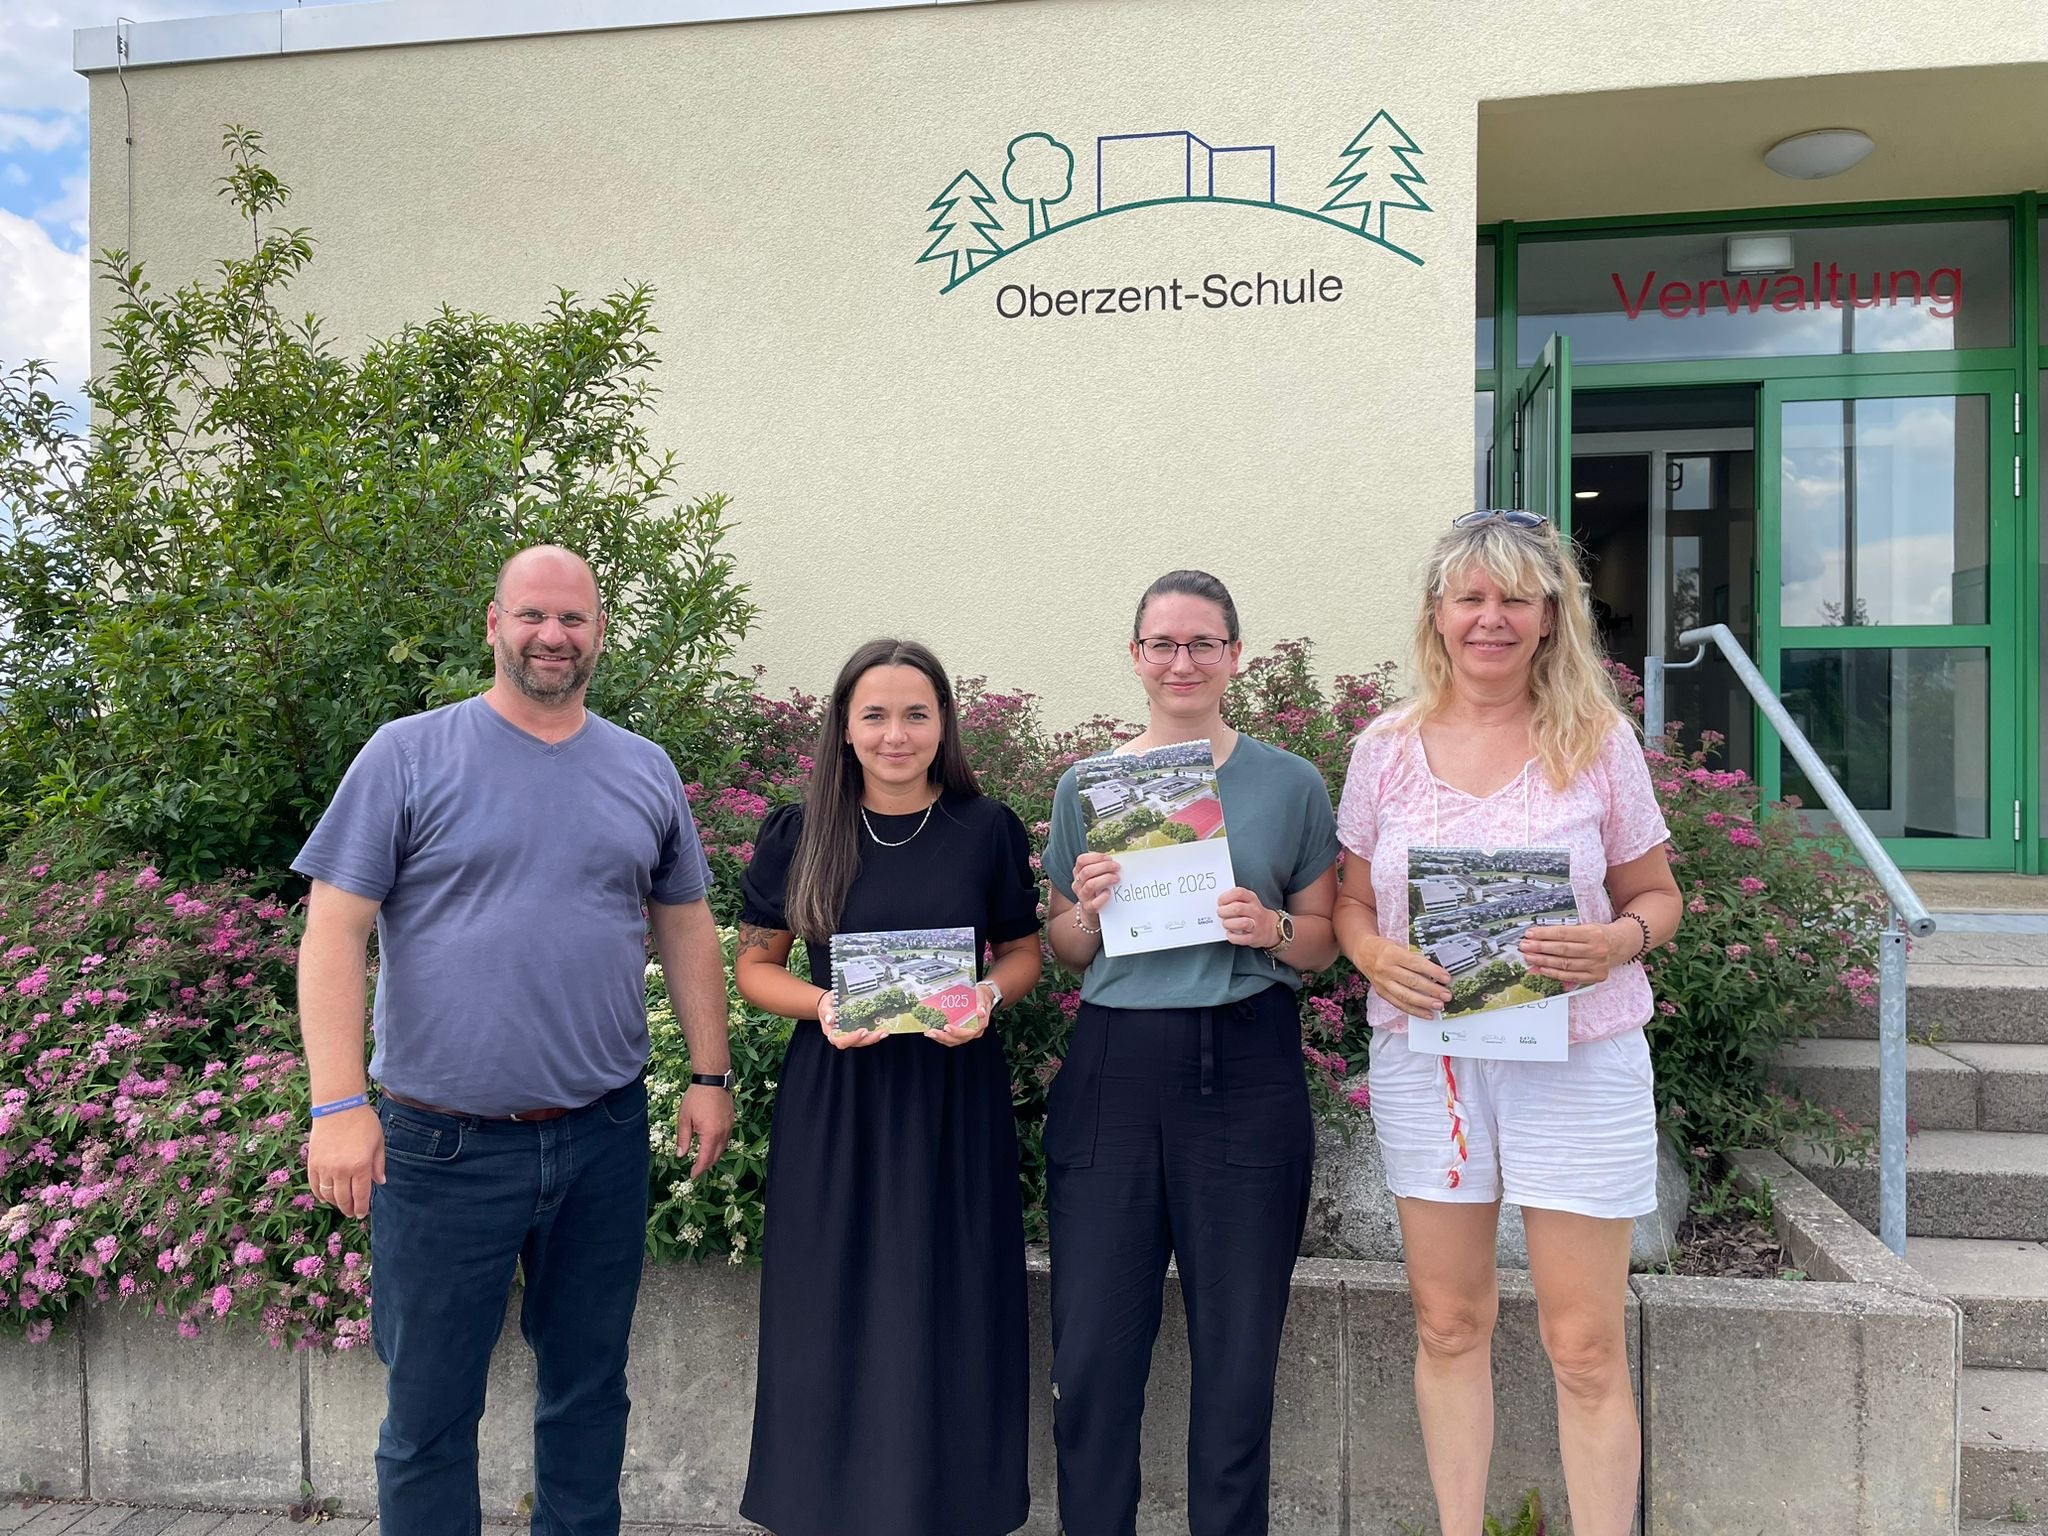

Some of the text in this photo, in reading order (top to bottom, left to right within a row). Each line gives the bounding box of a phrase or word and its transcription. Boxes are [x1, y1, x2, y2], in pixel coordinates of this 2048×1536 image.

[996, 268, 1343, 319] Oberzent-Schule
[1611, 261, 1962, 320] Verwaltung
[1113, 872, 1217, 903] Kalender 2025
[941, 994, 969, 1009] 2025
